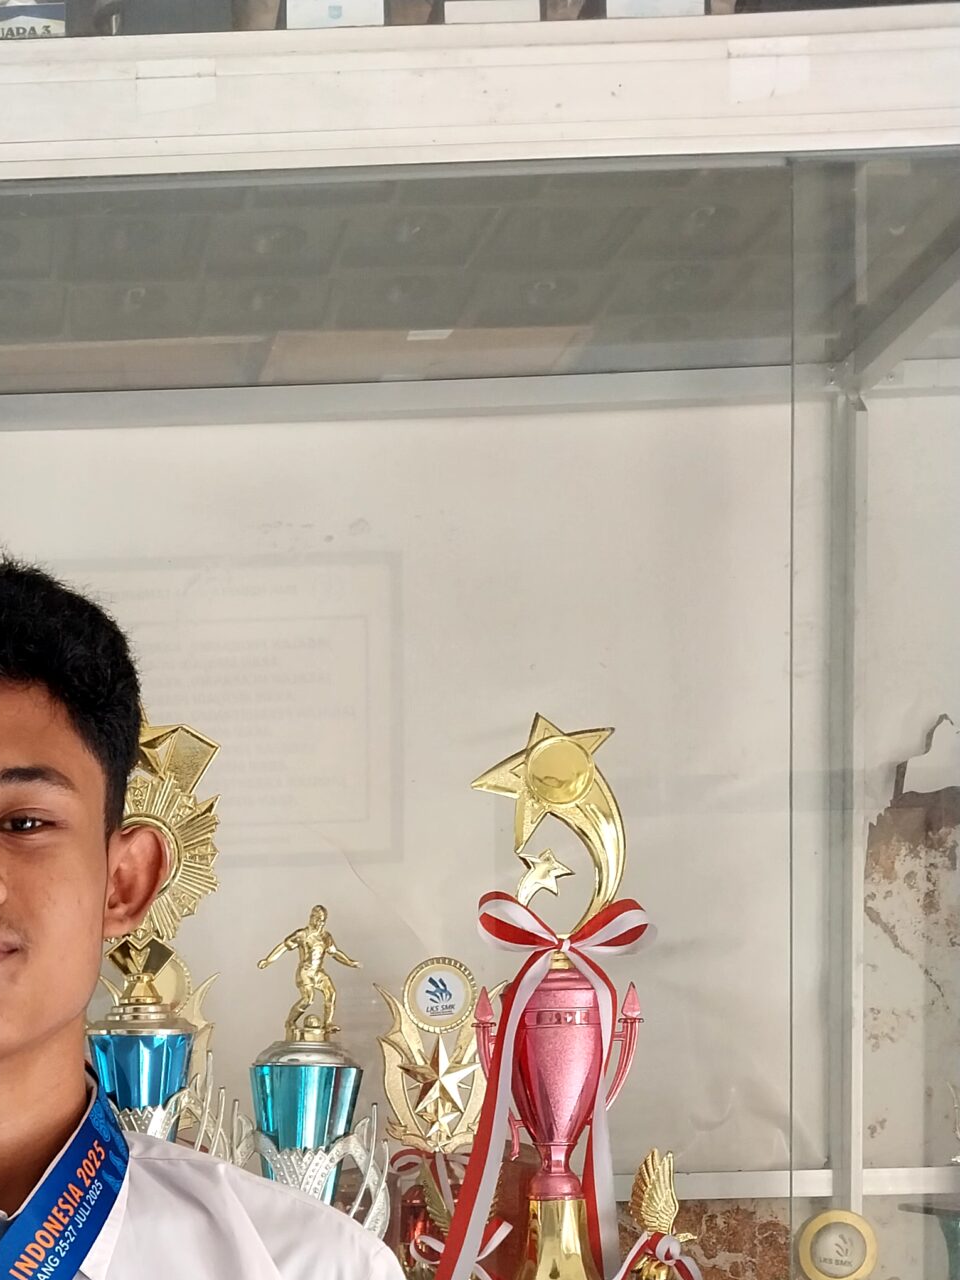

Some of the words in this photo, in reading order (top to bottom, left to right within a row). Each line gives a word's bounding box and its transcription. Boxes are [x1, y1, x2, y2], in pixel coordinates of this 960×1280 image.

[41, 25, 52, 36] 3
[426, 1005, 439, 1013] LKS
[76, 1140, 106, 1187] 2025
[54, 1226, 77, 1257] 25-27
[74, 1201, 92, 1228] JULI
[86, 1178, 103, 1206] 2025
